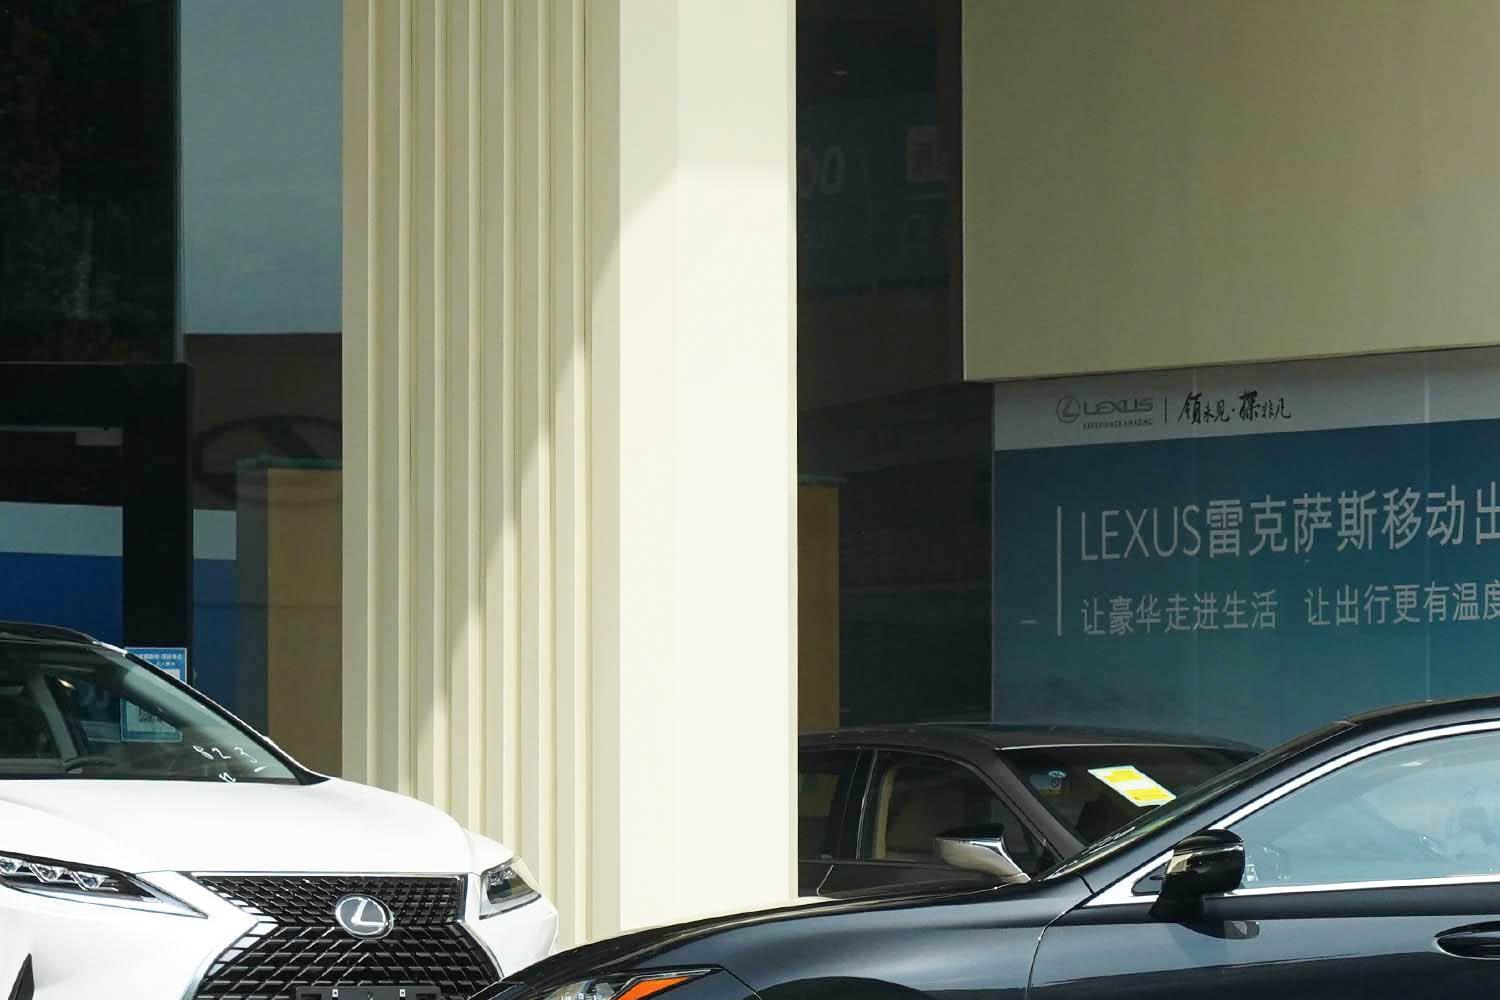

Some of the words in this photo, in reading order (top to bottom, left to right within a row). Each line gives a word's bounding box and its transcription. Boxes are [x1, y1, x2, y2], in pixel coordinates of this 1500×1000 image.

[1083, 398, 1154, 416] LEXUS
[1081, 588, 1280, 637] 让豪华走进生活
